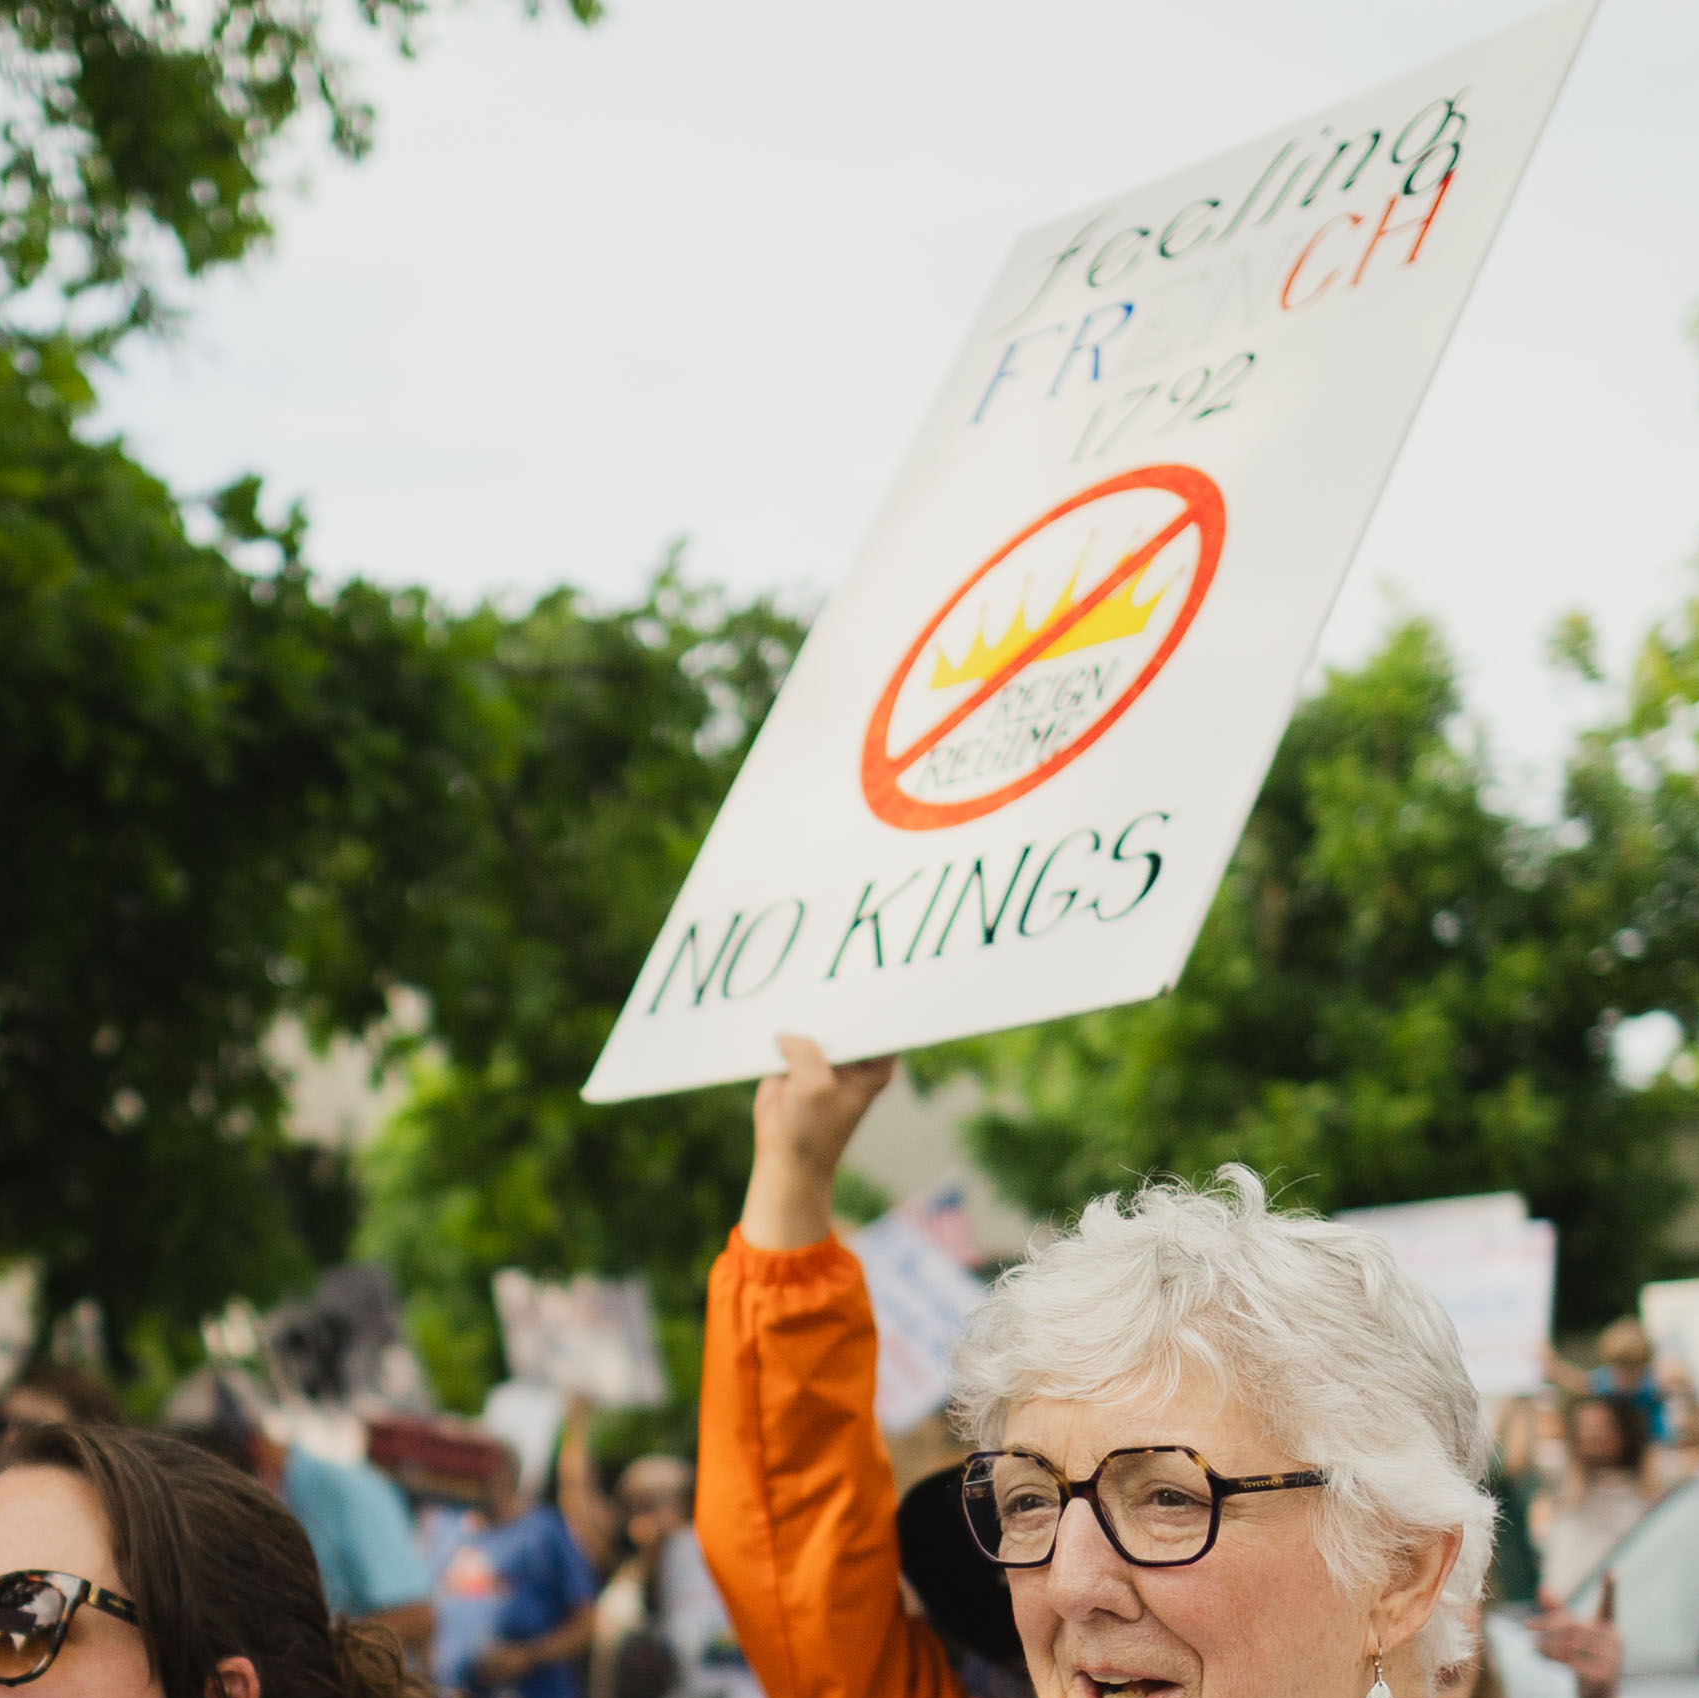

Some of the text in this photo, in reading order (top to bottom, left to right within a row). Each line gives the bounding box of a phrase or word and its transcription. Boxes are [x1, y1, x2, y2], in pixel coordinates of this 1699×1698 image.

[1070, 350, 1257, 464] 1792
[647, 811, 1174, 1017] NO KINGS
